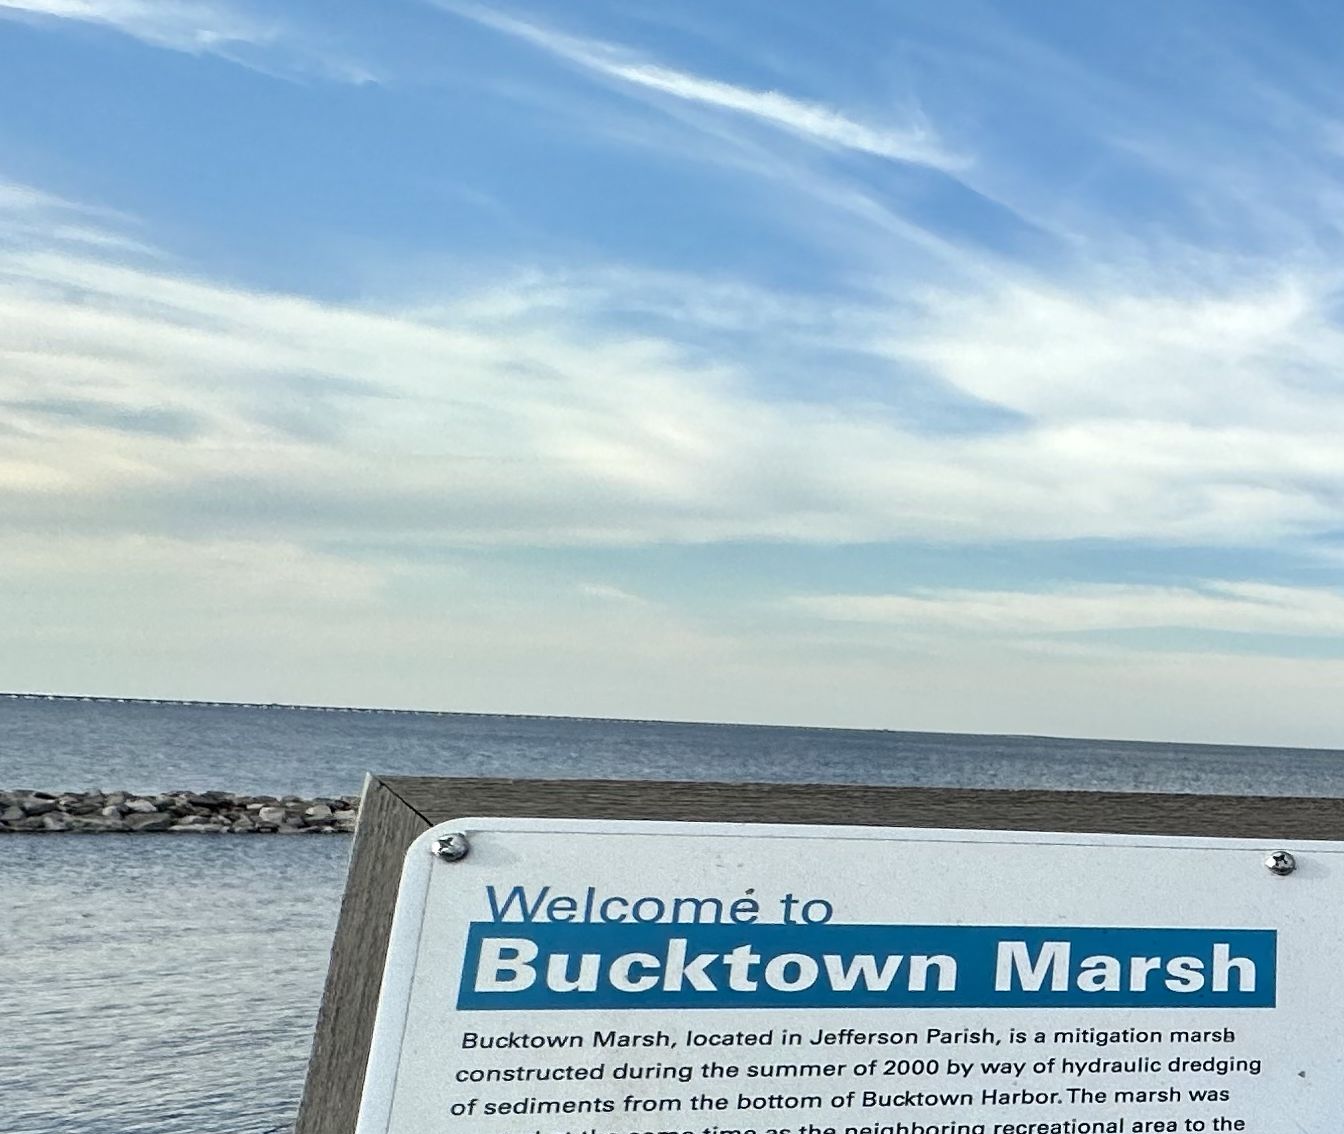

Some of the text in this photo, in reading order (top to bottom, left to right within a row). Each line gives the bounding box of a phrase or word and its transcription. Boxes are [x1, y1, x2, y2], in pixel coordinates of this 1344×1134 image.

[485, 885, 834, 925] Welcome to
[474, 937, 1257, 993] Bucktown Marsh
[461, 1027, 1236, 1050] Bucktown Marsh, located in Jefferson Parish, is a mitigation marsh
[455, 1055, 1262, 1083] constructed during the summer of 2000 by way of hydraulic dredging
